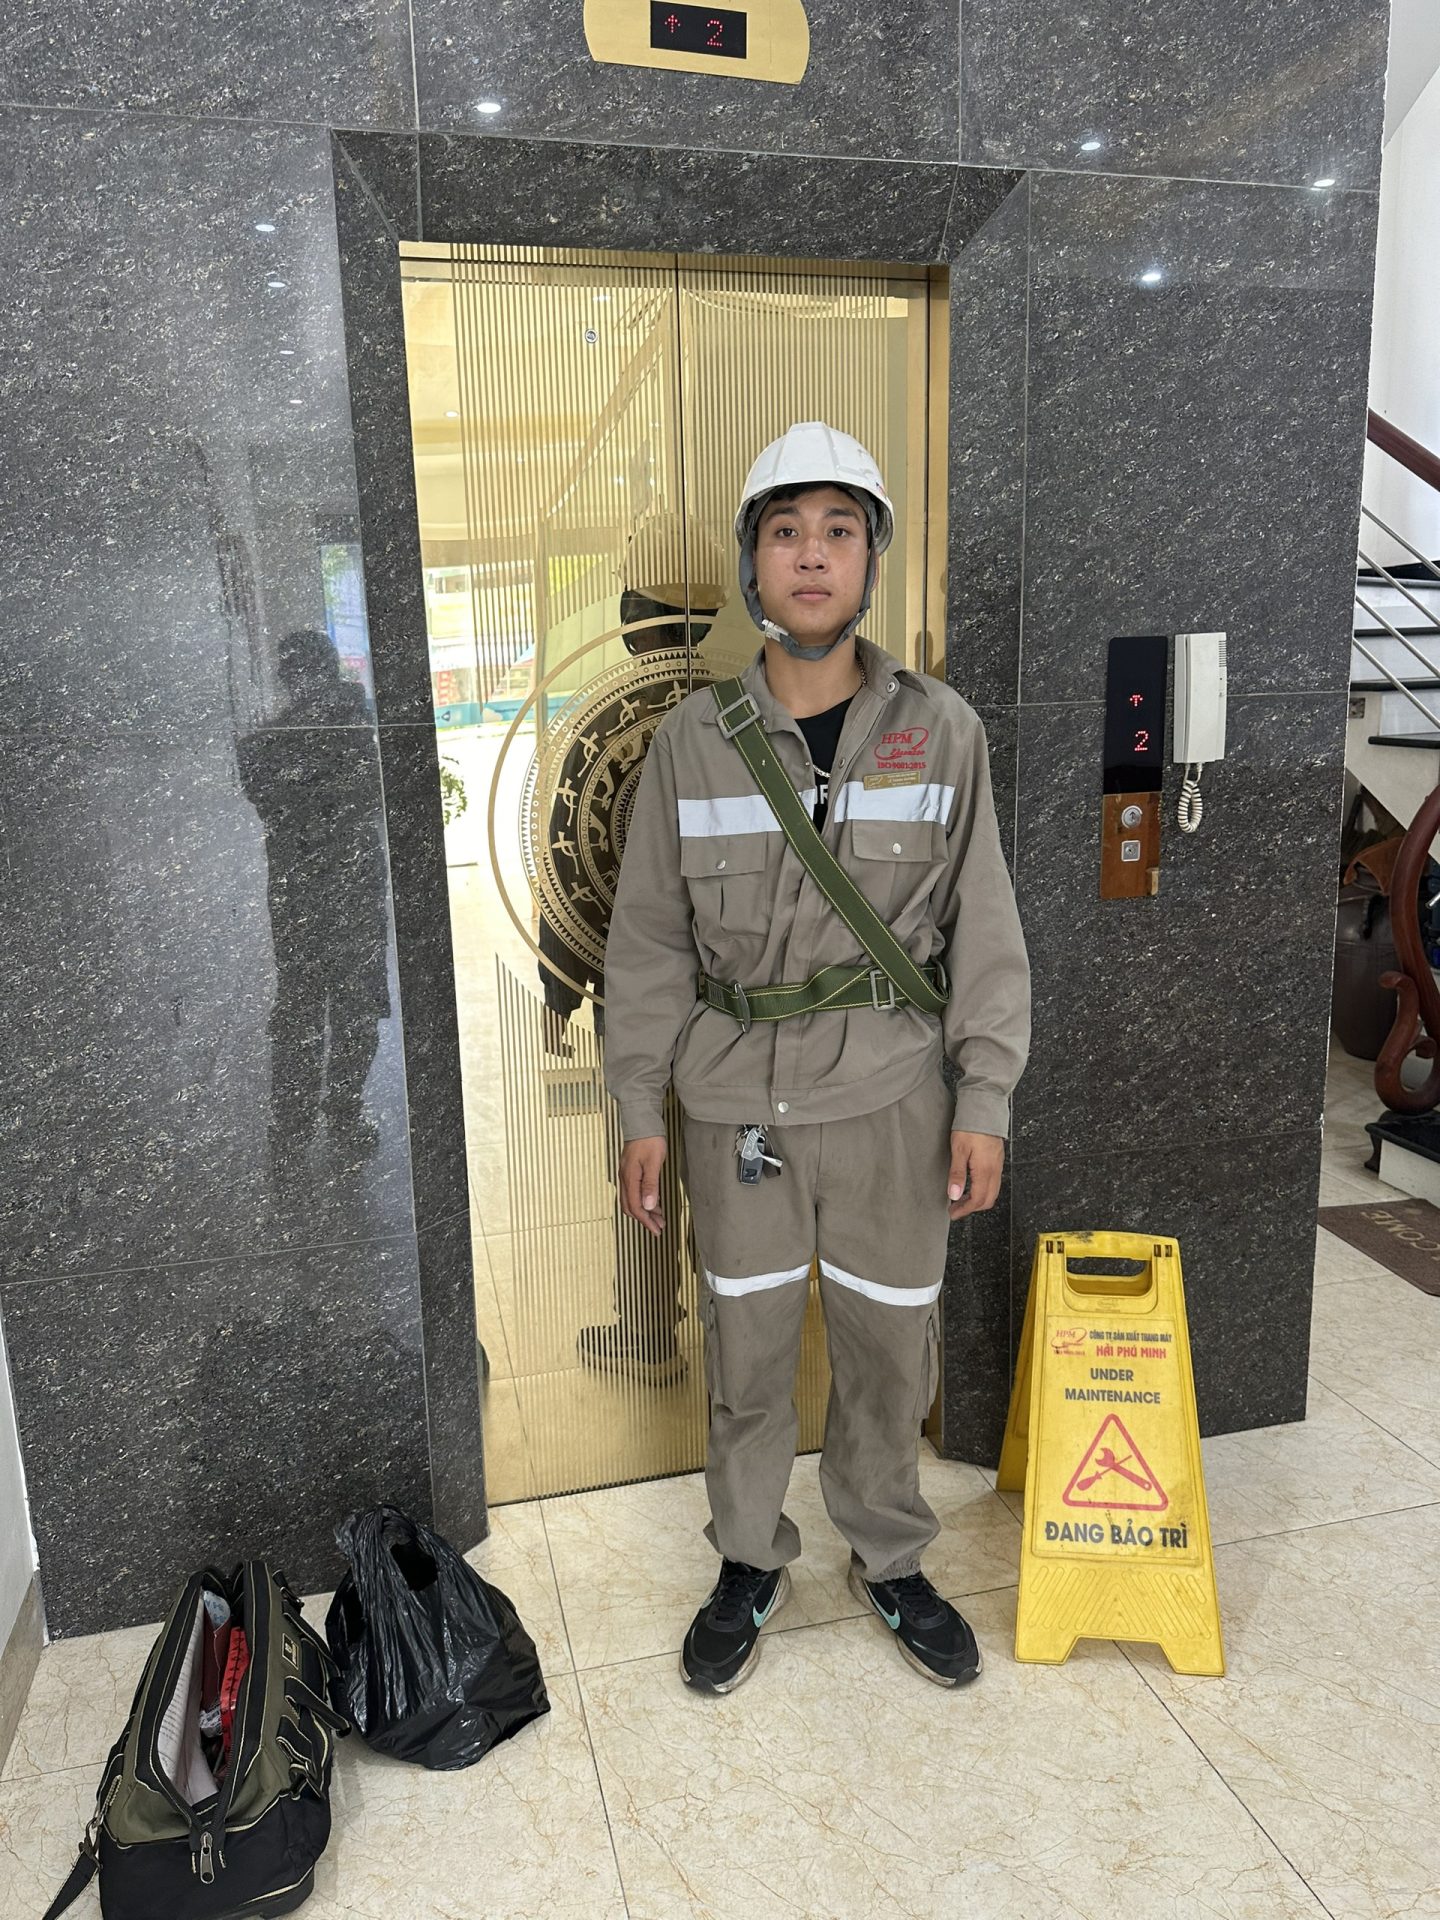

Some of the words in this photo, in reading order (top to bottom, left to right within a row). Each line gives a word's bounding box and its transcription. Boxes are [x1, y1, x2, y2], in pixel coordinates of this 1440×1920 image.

[707, 18, 723, 47] 2
[881, 732, 913, 744] HPM
[1134, 731, 1149, 751] 2
[1089, 1329, 1104, 1340] CÔNG
[1140, 1332, 1159, 1342] THANG
[1096, 1342, 1114, 1357] HẢI
[1117, 1344, 1138, 1358] PHÚ
[1140, 1347, 1167, 1359] MINH
[1090, 1367, 1134, 1382] UNDER
[1065, 1387, 1161, 1404] MAINTENANCE
[1045, 1521, 1105, 1544] ĐANG
[1111, 1518, 1154, 1547] BẢO
[1159, 1522, 1188, 1548] TRÌ
